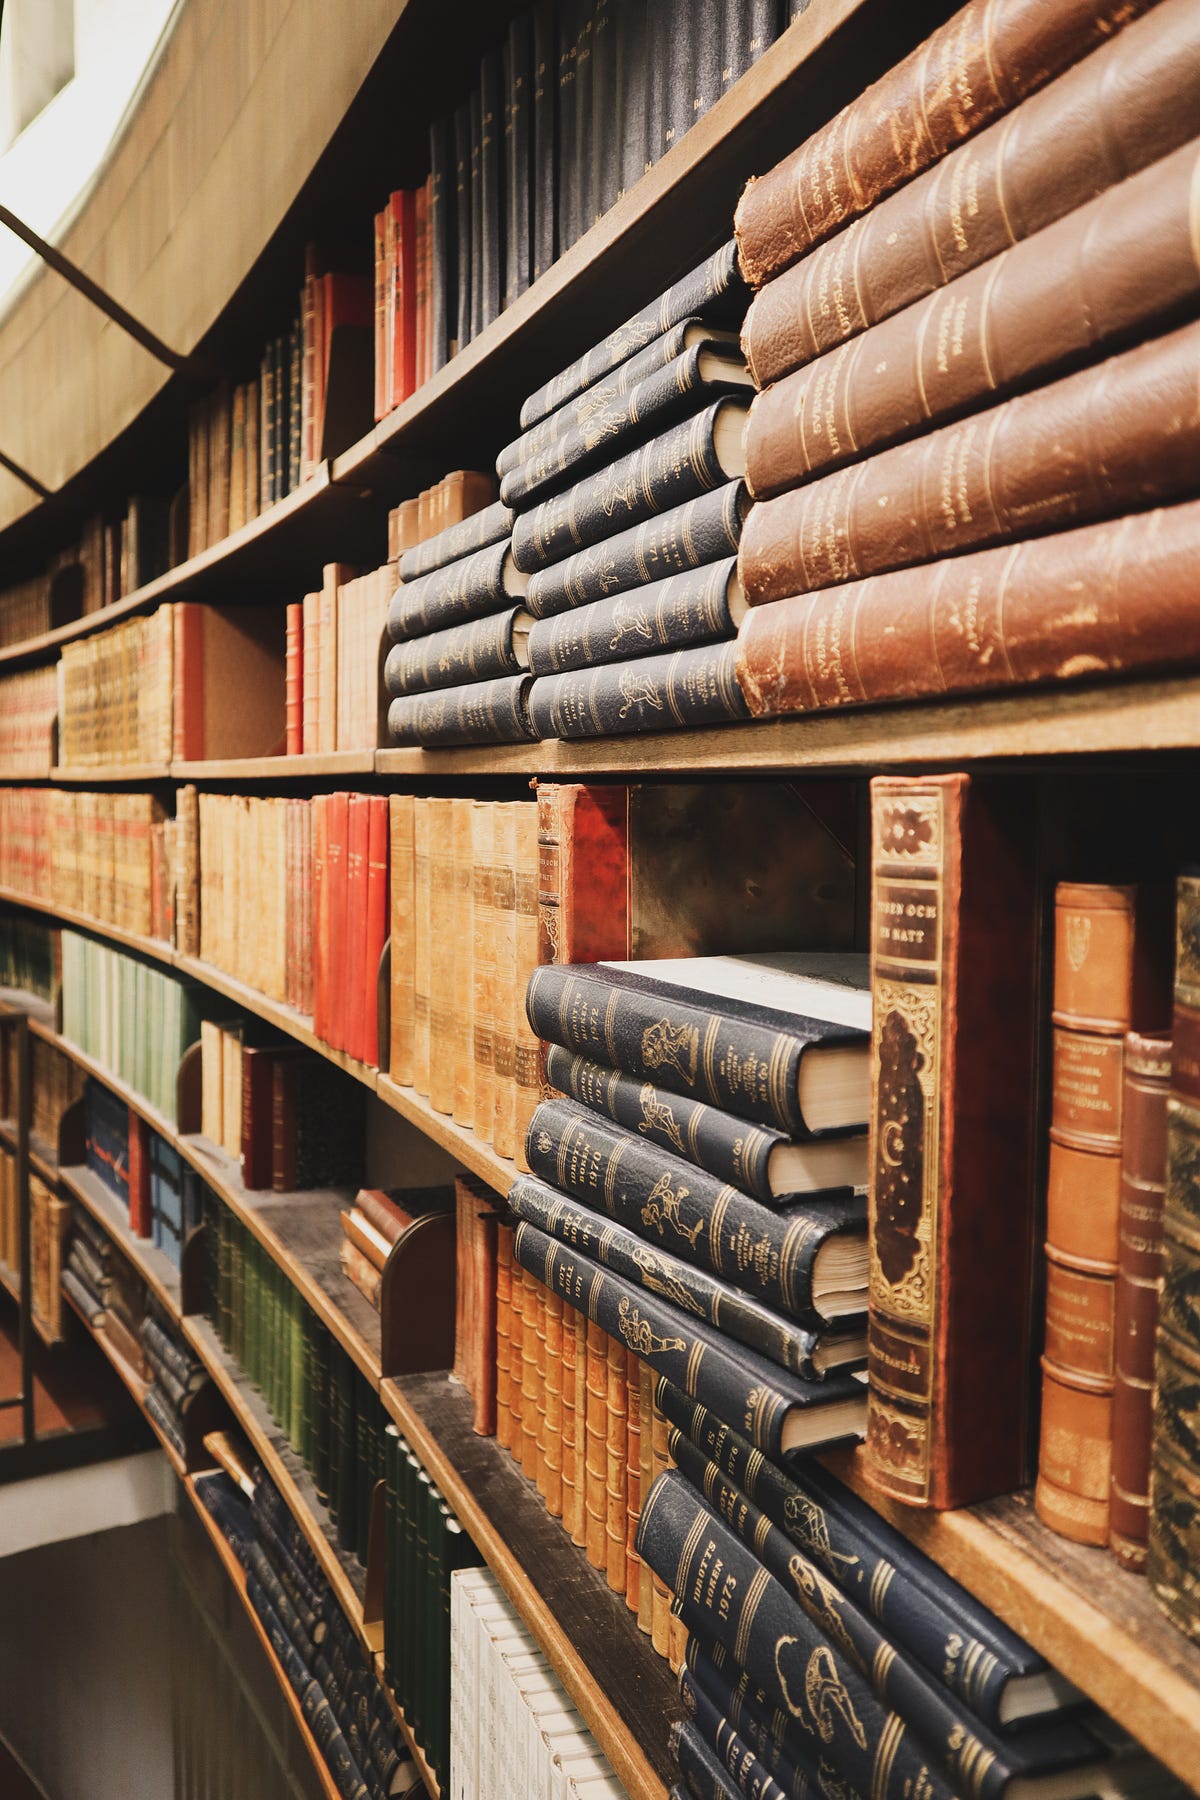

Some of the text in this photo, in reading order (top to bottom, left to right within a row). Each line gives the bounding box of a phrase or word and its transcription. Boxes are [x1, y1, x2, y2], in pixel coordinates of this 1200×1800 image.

[906, 904, 937, 919] OCH
[893, 928, 925, 943] NATT
[581, 1002, 589, 1040] BOKEN
[591, 1008, 600, 1041] 1972
[570, 1132, 585, 1185] IDROTTS
[579, 1143, 591, 1183] BOKEN
[589, 1151, 602, 1189] 1970
[571, 1214, 584, 1244] BOLL
[559, 1263, 567, 1288] FOT
[565, 1265, 575, 1295] BOLL
[575, 1275, 584, 1299] 1971
[707, 1431, 717, 1446] IS
[728, 1446, 740, 1476] 1976
[693, 1540, 717, 1604] IDROTTS
[705, 1558, 725, 1608] BOKEN
[718, 1573, 738, 1621] 1973
